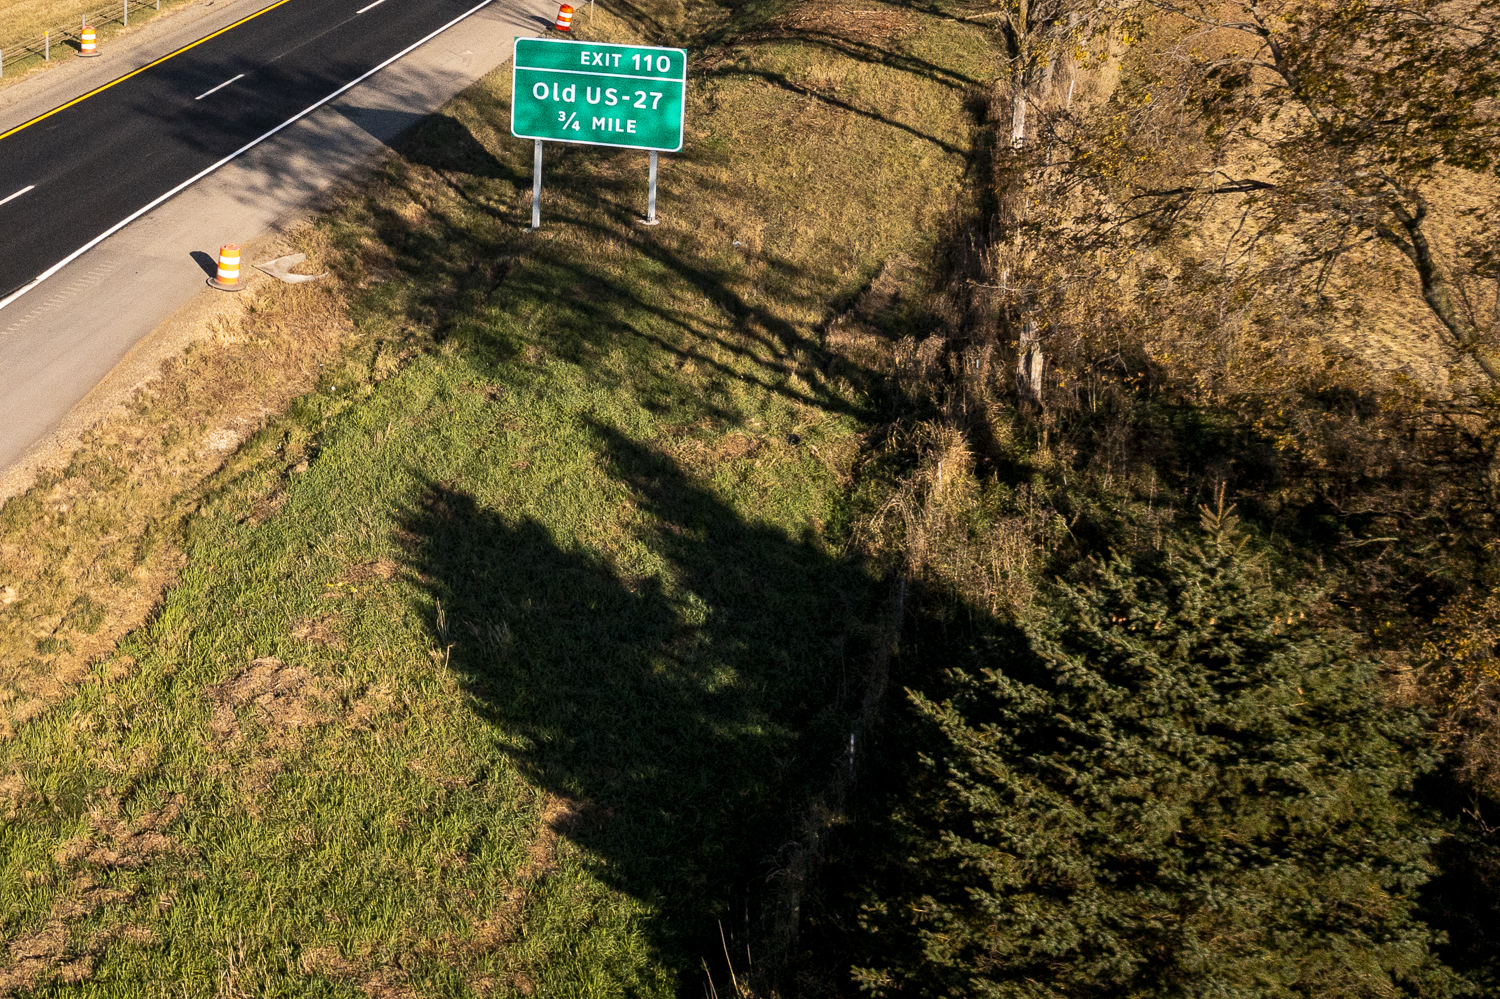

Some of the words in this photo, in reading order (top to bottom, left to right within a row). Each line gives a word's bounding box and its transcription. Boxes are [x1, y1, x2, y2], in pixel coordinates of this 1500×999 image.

[580, 51, 622, 67] EXIT
[632, 53, 671, 73] 110
[532, 82, 576, 103] Old
[585, 86, 663, 110] US-27
[591, 116, 637, 134] MILE
